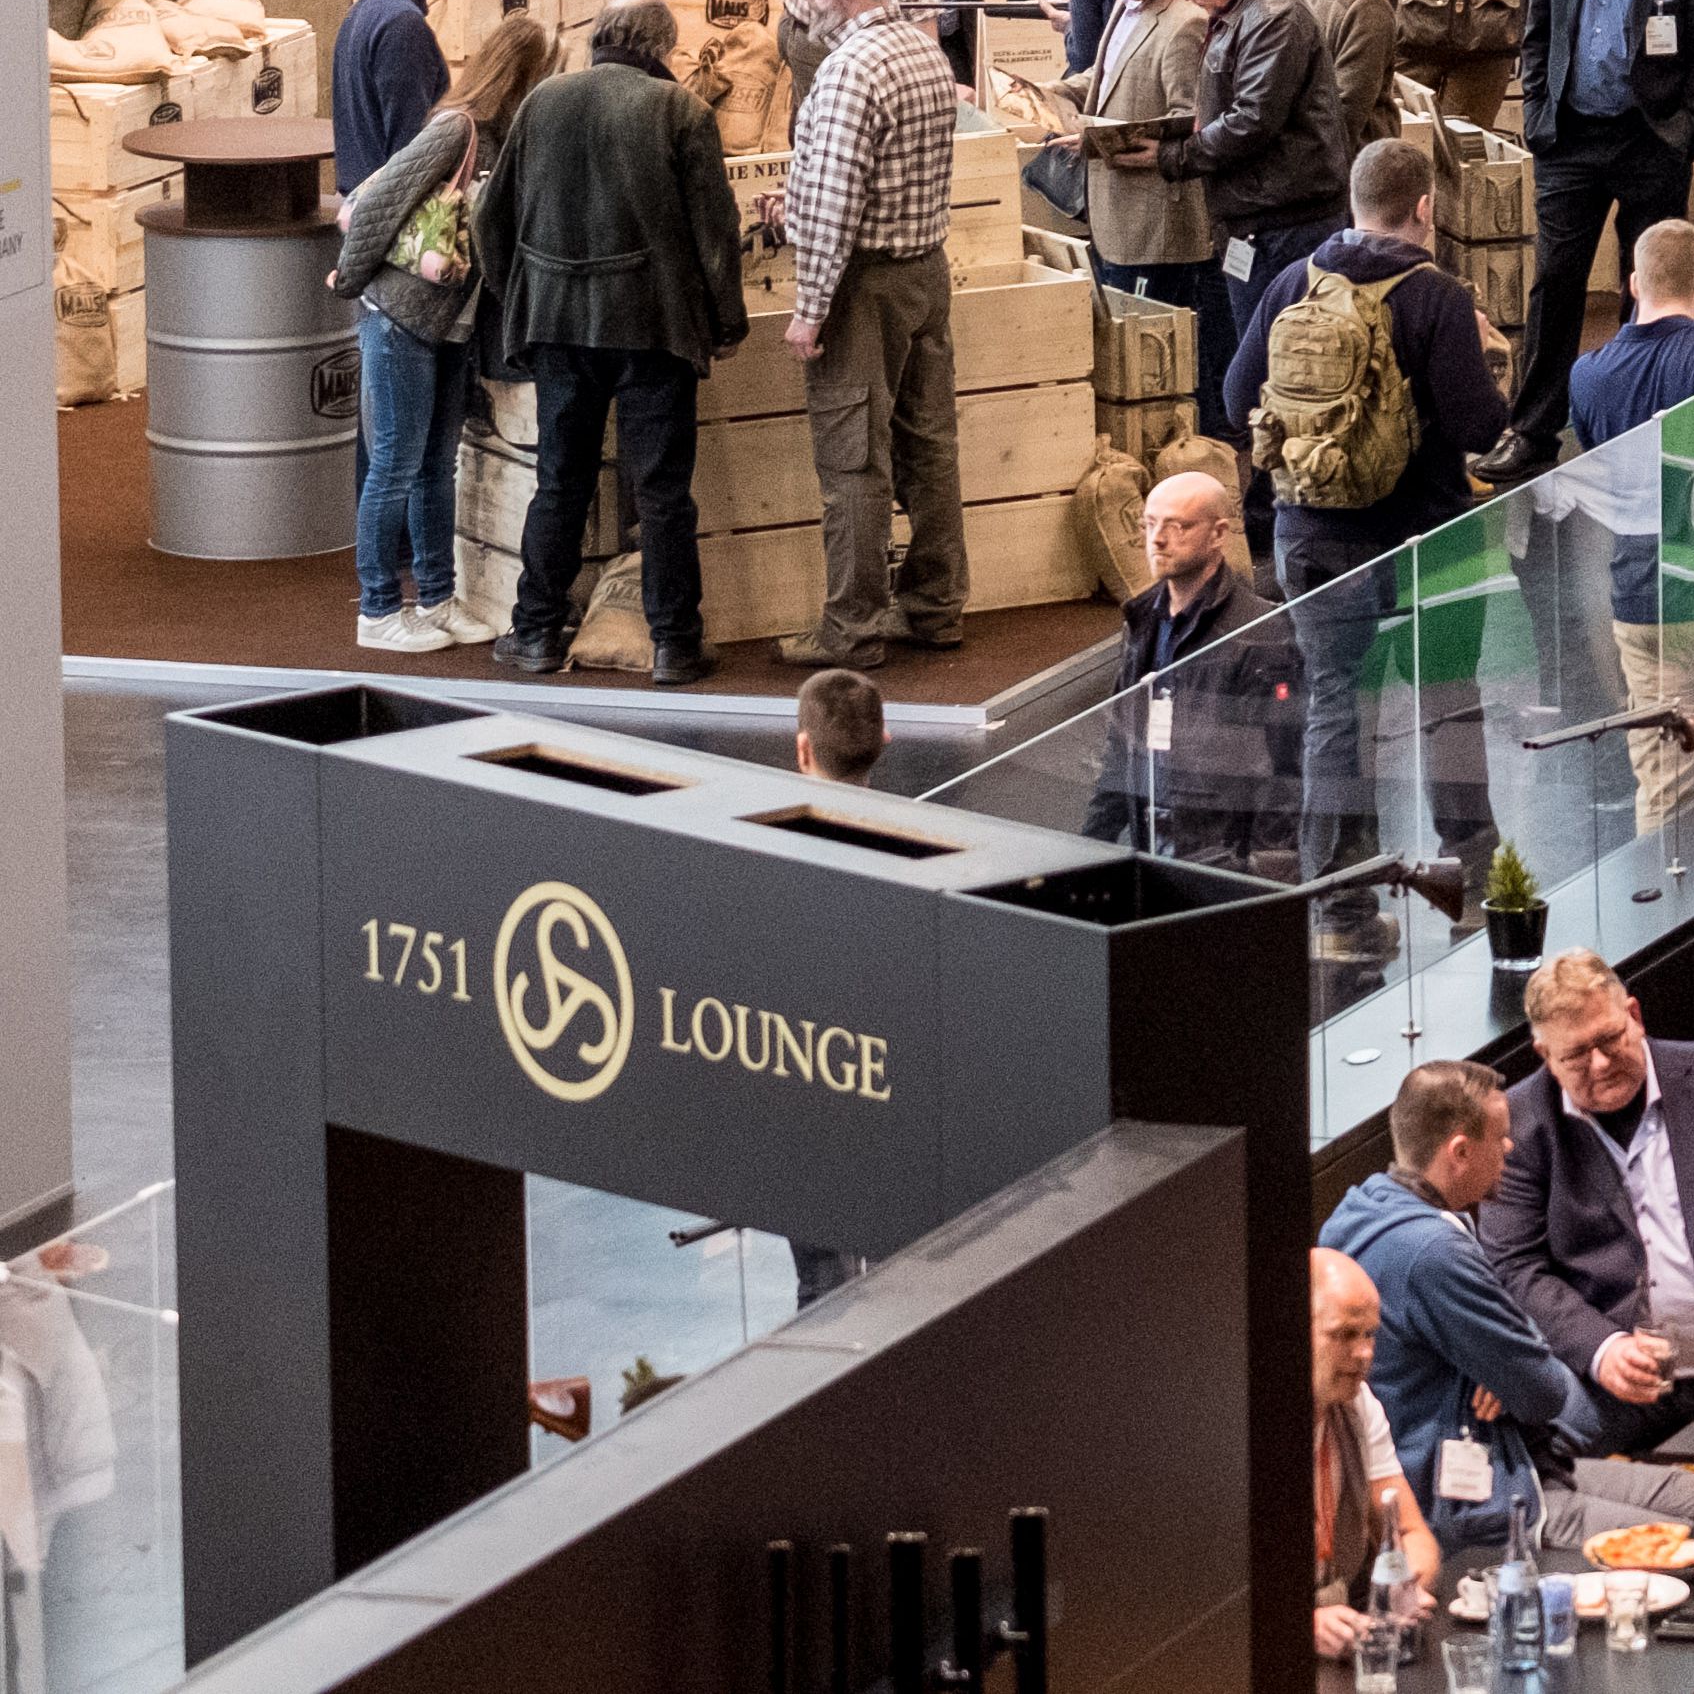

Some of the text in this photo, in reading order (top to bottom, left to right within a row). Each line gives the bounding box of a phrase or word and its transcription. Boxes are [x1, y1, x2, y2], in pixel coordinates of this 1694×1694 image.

[728, 165, 749, 181] IE
[362, 918, 891, 1102] 1751 LOUNGE
